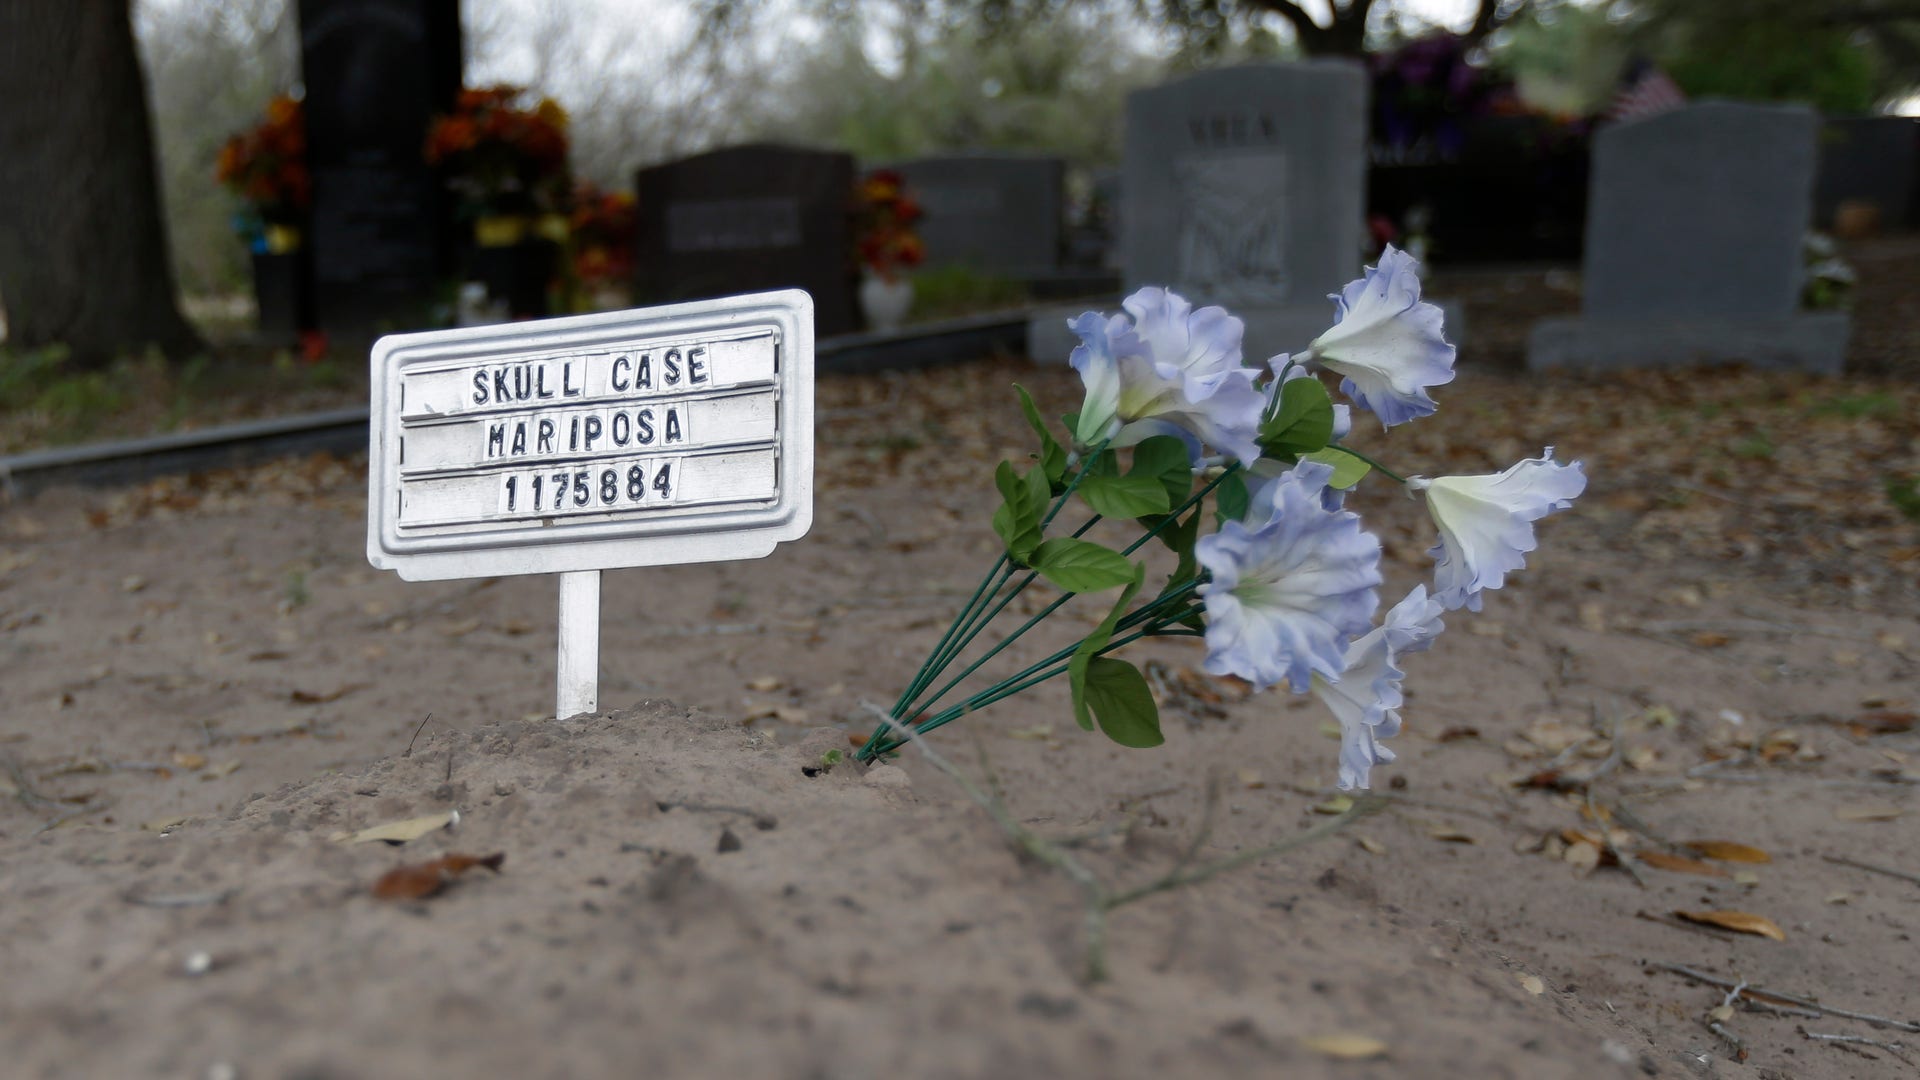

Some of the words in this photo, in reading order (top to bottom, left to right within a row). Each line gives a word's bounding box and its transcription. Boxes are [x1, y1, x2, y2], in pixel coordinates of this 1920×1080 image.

[473, 363, 580, 405] SKULL
[611, 347, 708, 392] CASE
[488, 408, 683, 458] MARIPOSA
[505, 463, 673, 510] 1175884
